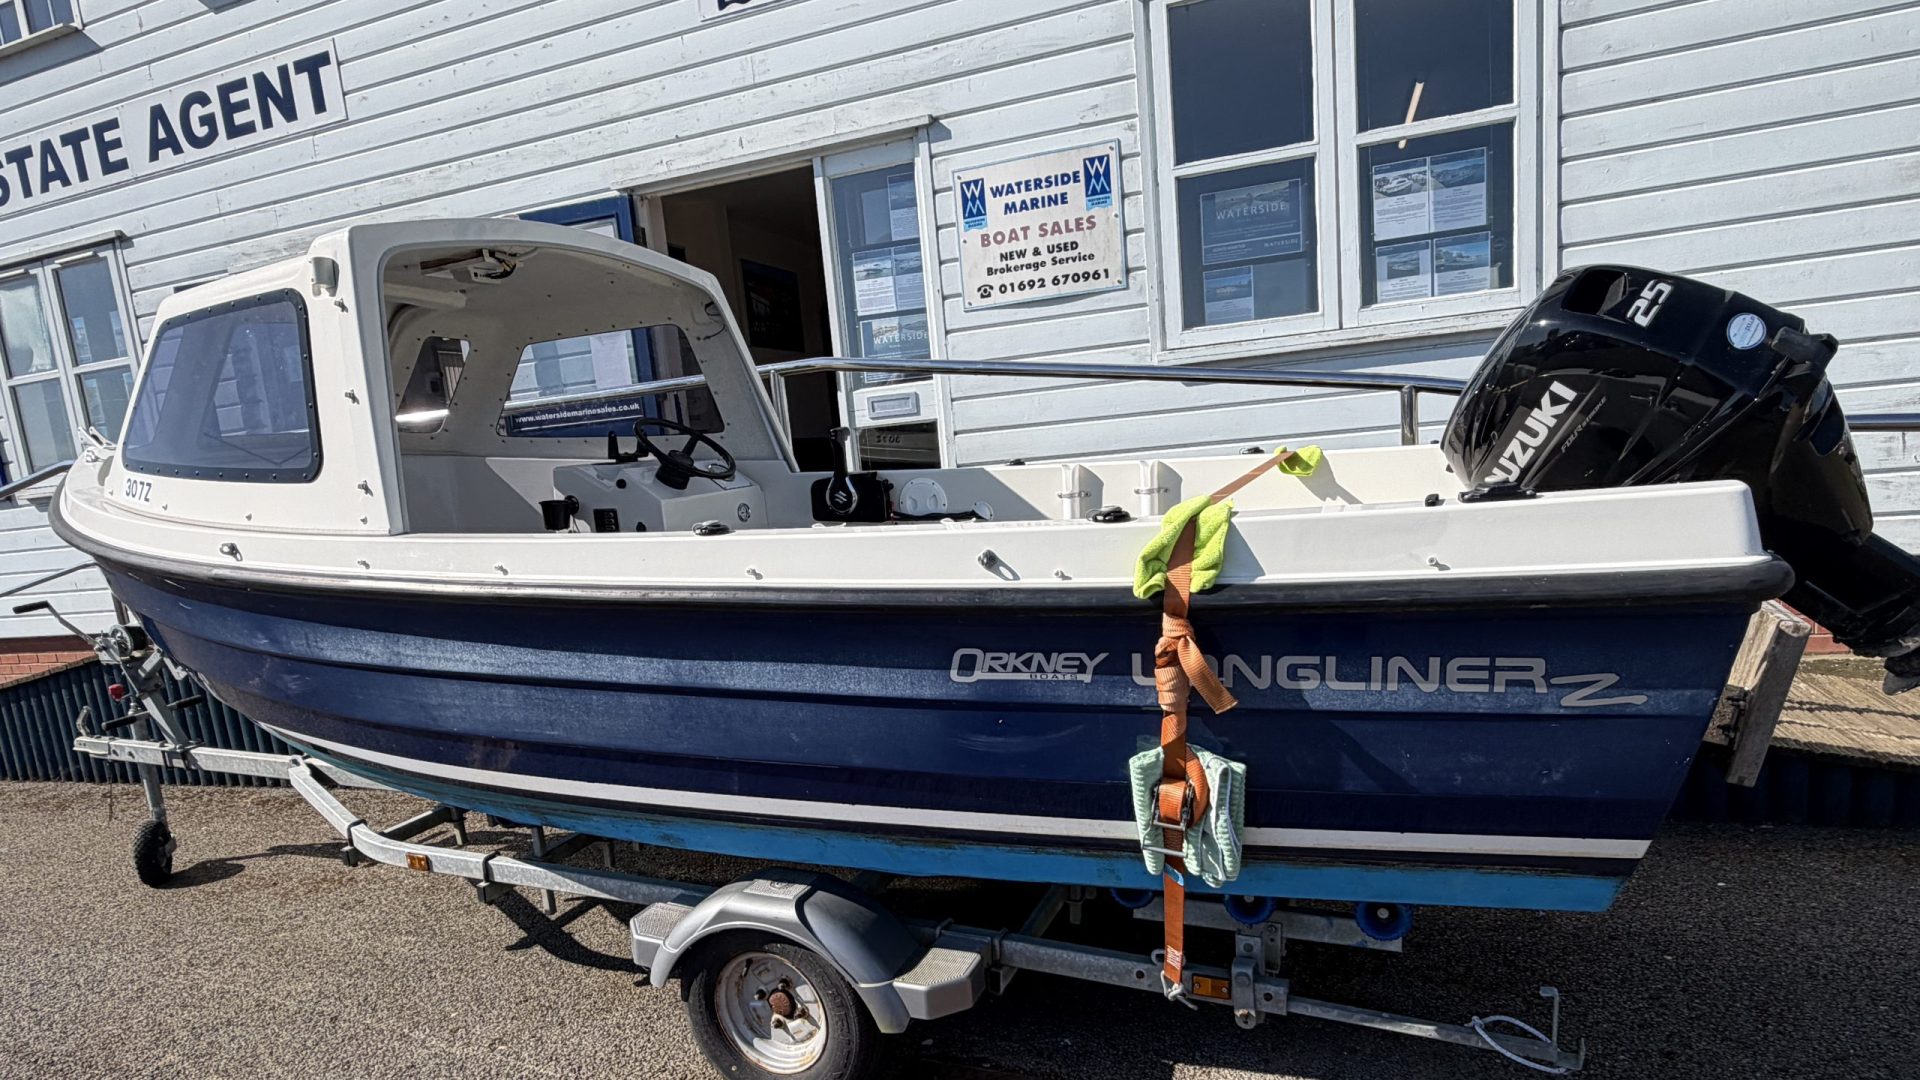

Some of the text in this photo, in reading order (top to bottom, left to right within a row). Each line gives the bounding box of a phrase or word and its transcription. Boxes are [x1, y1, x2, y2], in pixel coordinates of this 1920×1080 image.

[149, 50, 331, 163] AGENT
[990, 170, 1081, 199] WATERSIDE
[1003, 192, 1069, 216] MARINE
[1216, 201, 1287, 220] WATERSIDE
[980, 215, 1097, 248] BOAT SALES
[987, 252, 1095, 276] Brokerage Service
[1000, 241, 1079, 262] NEW & USED
[999, 268, 1110, 295] 01692 670961
[1626, 279, 1674, 327] 25
[873, 331, 928, 345] WATERSIDE
[515, 403, 640, 423] www.watersidemarinesales.co.uk
[1491, 380, 1578, 482] UZUKI
[126, 478, 152, 502] 307Z
[950, 648, 1109, 683] ORKNEY
[1029, 673, 1078, 681] BOATS
[1131, 653, 1648, 707] LNGLINER Z
